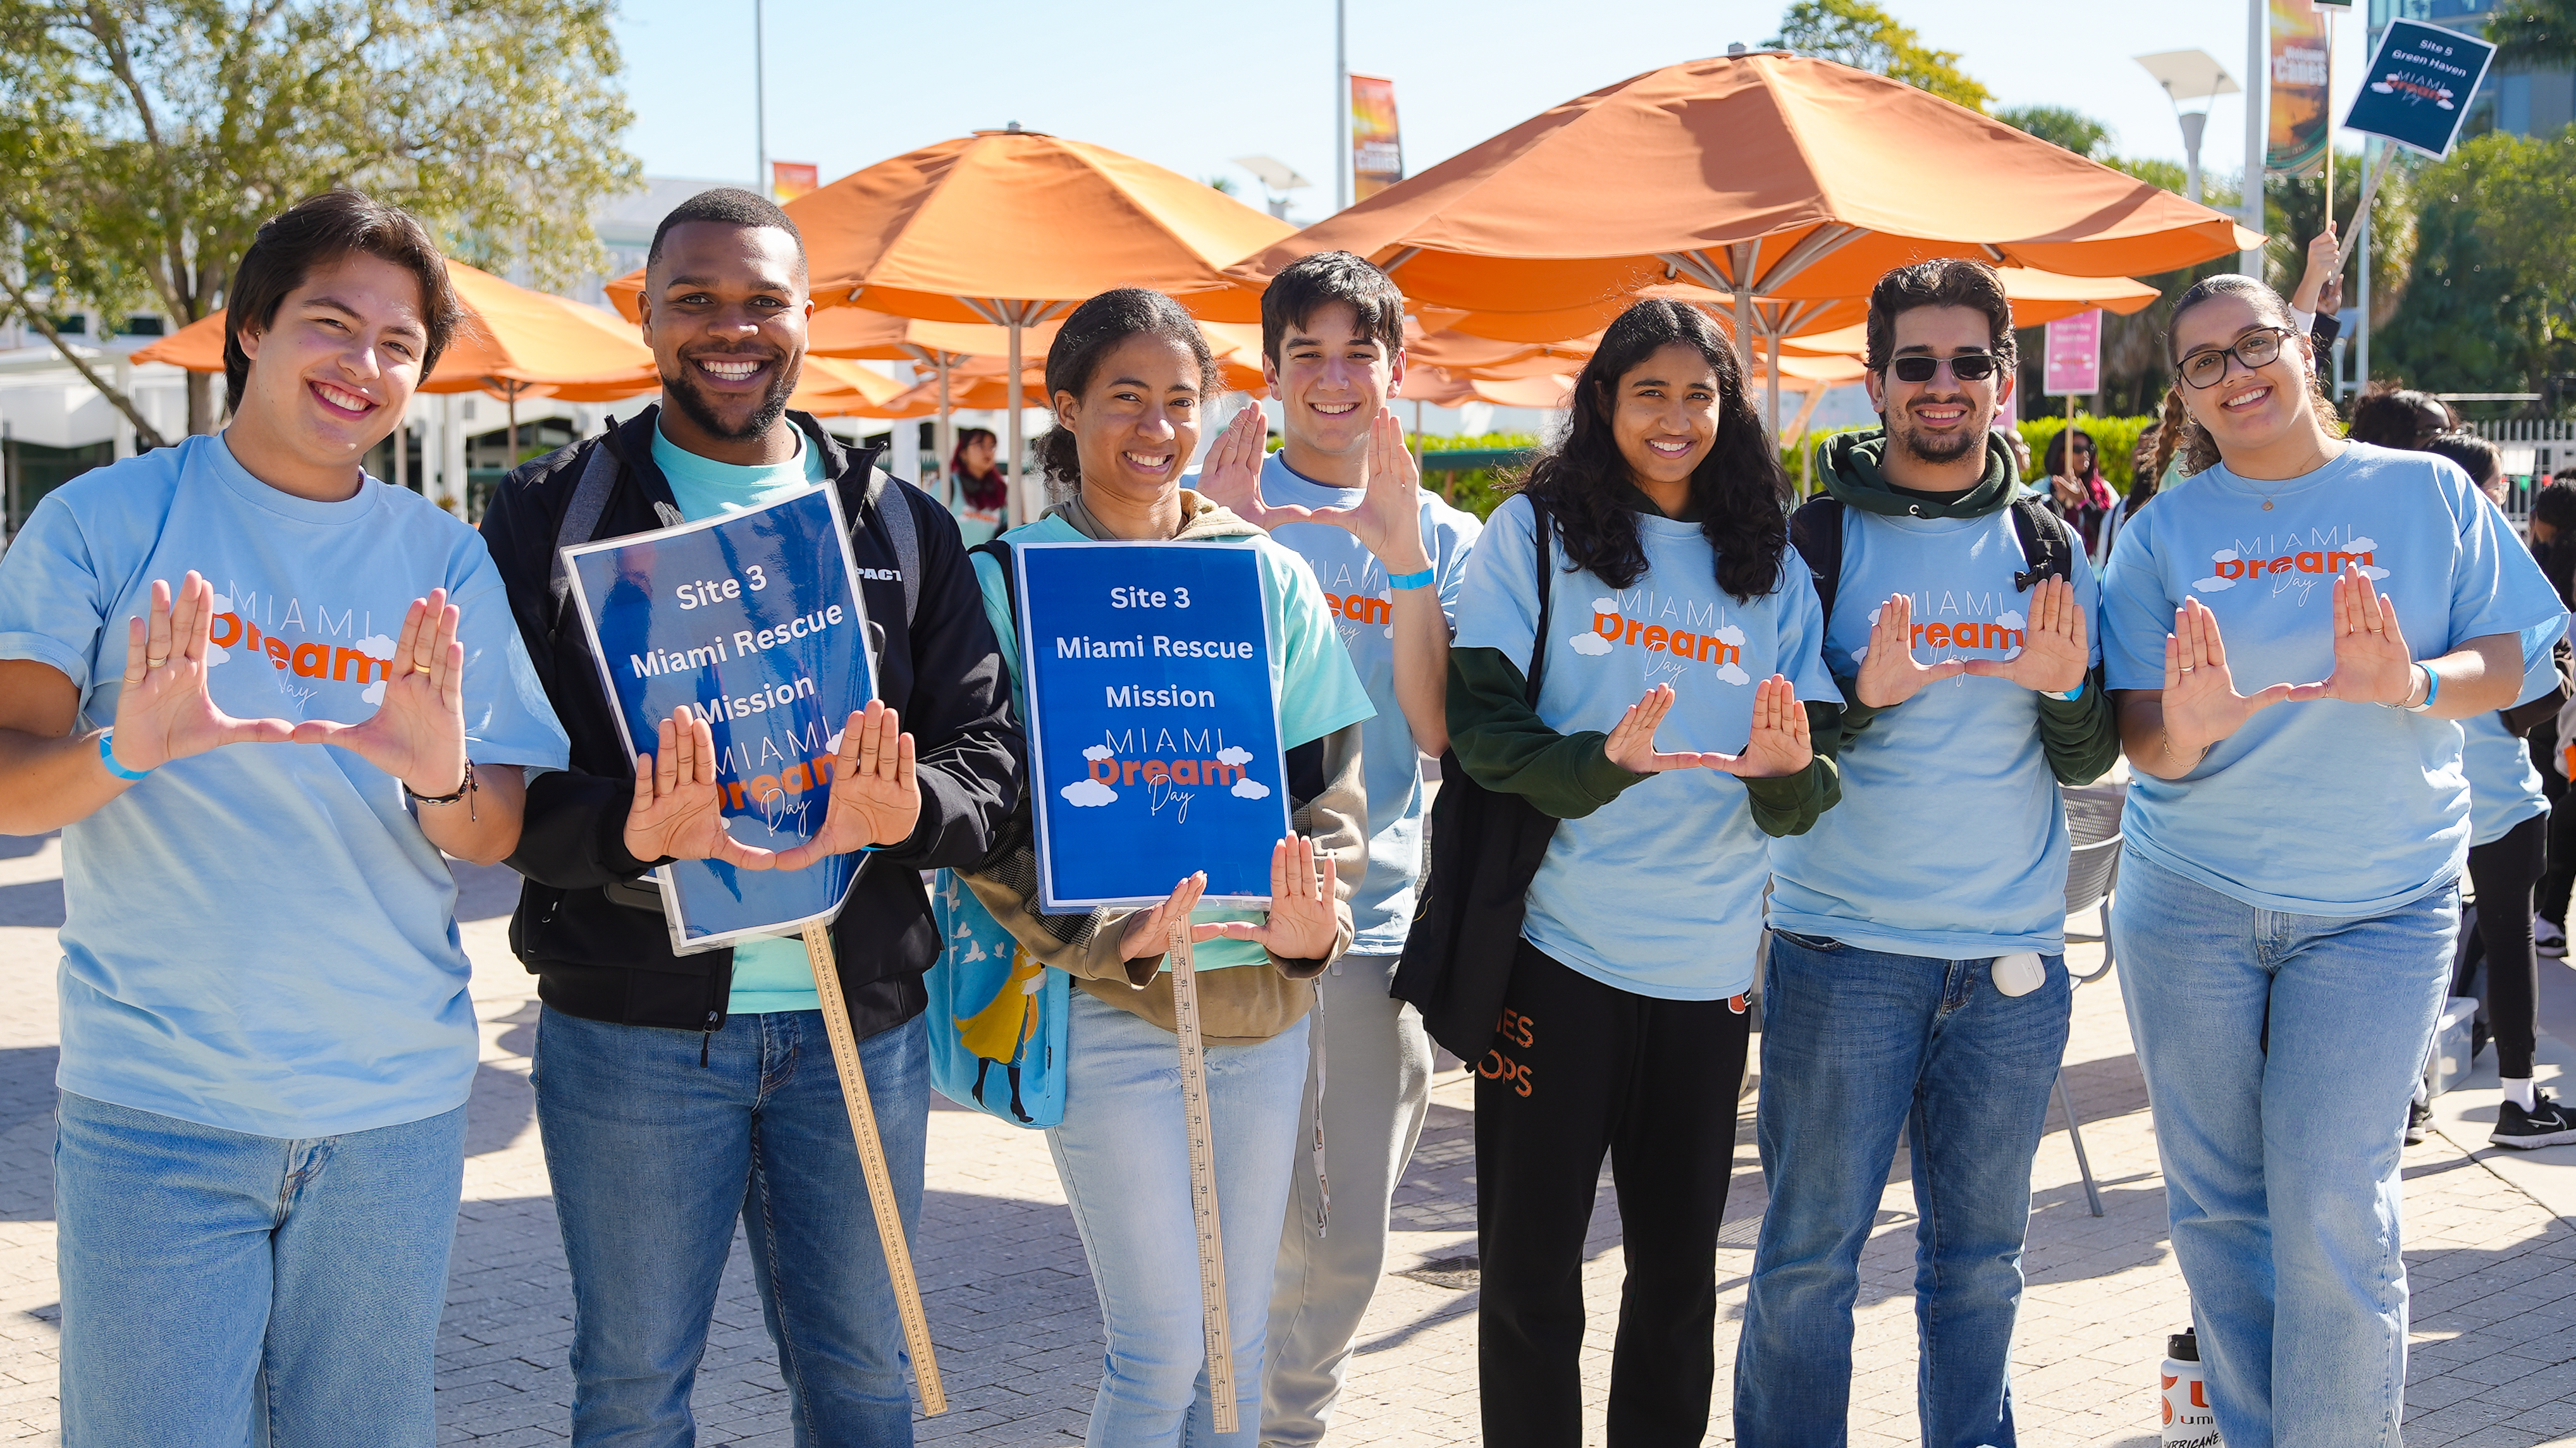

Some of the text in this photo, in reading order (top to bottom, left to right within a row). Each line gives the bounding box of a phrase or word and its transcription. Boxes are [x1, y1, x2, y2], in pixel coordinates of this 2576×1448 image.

[2419, 39, 2443, 53] Site
[2391, 49, 2467, 78] Green Haven
[2397, 70, 2446, 90] MIAMI
[2234, 524, 2351, 555] MIAMI
[2215, 550, 2373, 580] Dream
[677, 565, 767, 610] Site 3
[1111, 586, 1190, 608] Site 3
[2271, 562, 2317, 608] Day
[230, 579, 370, 640] MIAMI
[1617, 589, 1725, 629] MIAMI
[209, 612, 393, 684] Dream
[631, 604, 843, 678] Miami Rescue
[1057, 635, 1252, 658] Miami Rescue
[1593, 612, 1740, 665] Dream
[1910, 622, 2024, 649] ream
[1644, 641, 1688, 688] Day
[270, 654, 318, 715] Day
[1107, 685, 1214, 707] Mission
[694, 677, 815, 725] Mission
[1106, 728, 1224, 753] MIAMI
[1088, 758, 1246, 786] Dream
[760, 788, 811, 837] Day
[1148, 773, 1195, 824] Day
[1178, 957, 1186, 966] 20
[1183, 1001, 1190, 1010] 18
[1496, 1007, 1534, 1048] ES
[1188, 1047, 1195, 1055] 16
[1190, 1070, 1197, 1078] 15
[1194, 1115, 1201, 1124] 13
[1196, 1139, 1203, 1147] 12
[1200, 1186, 1207, 1194] 10
